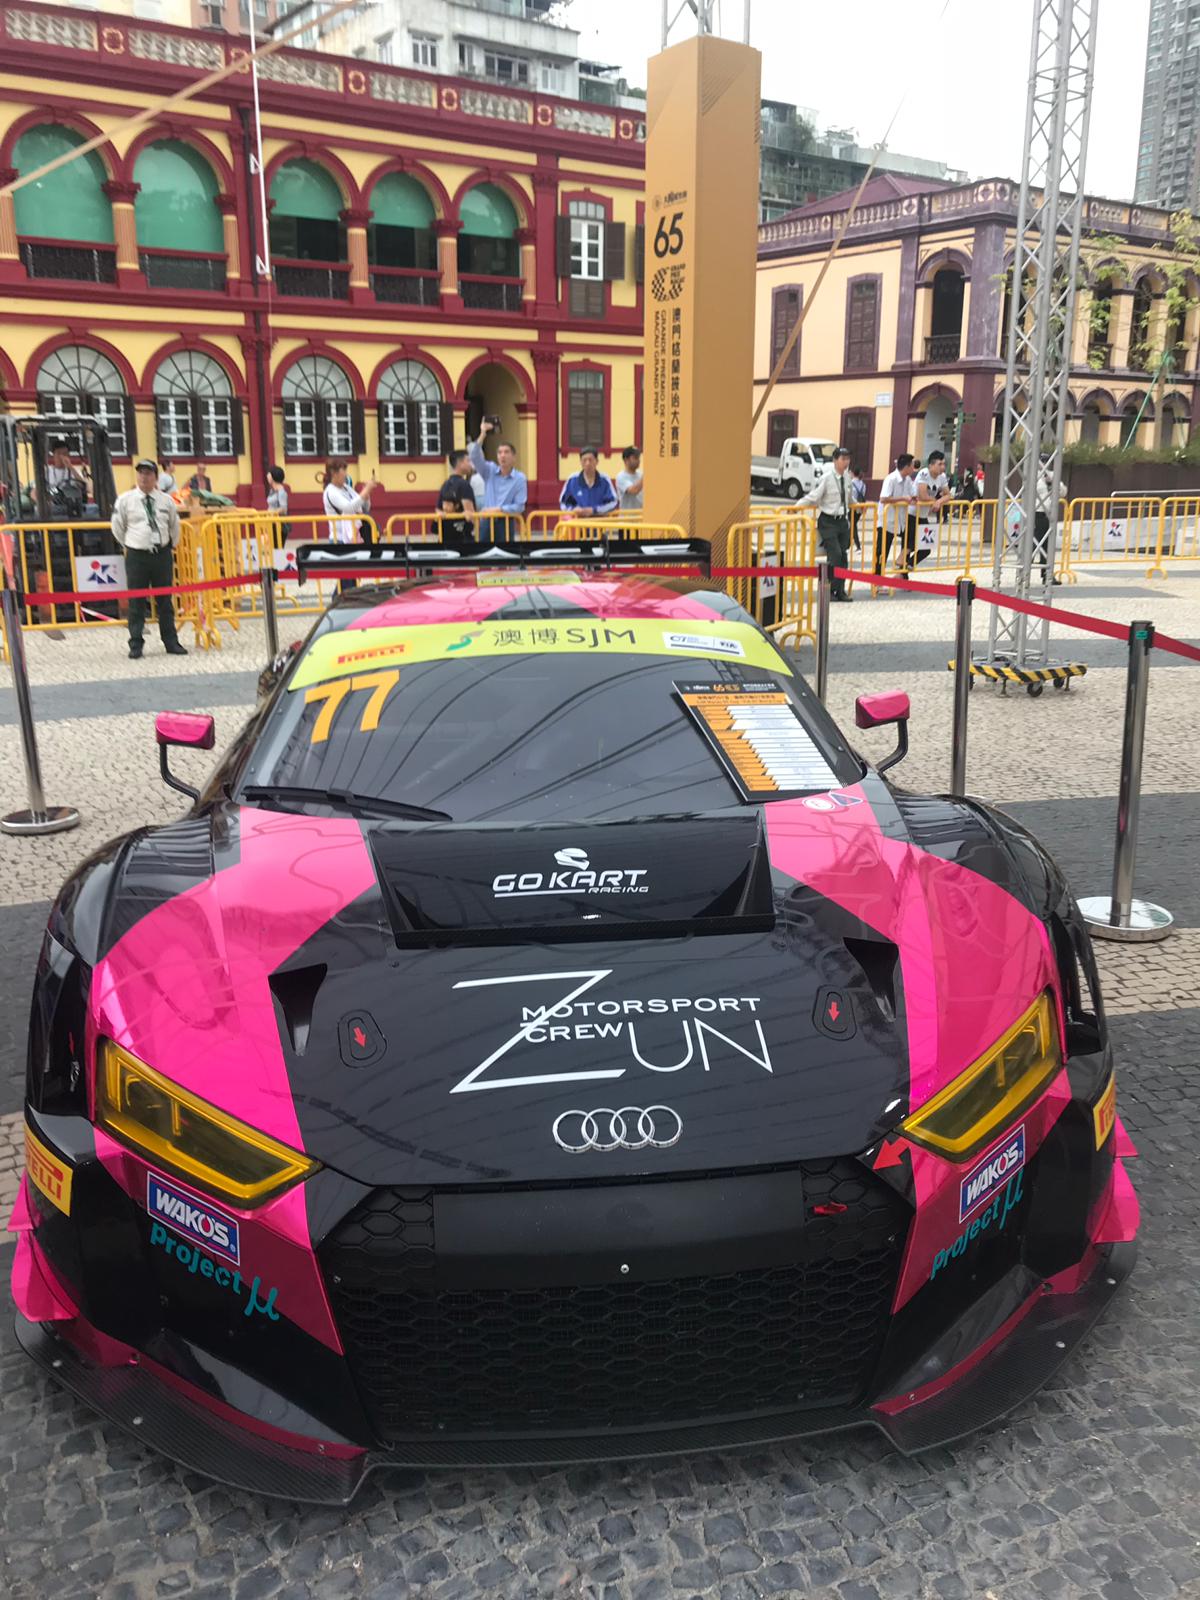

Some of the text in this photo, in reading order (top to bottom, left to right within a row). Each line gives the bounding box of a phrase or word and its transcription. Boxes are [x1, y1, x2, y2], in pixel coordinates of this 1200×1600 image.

[653, 212, 684, 259] 65
[659, 403, 666, 417] DE
[493, 628, 560, 647] 澳博
[566, 628, 637, 648] SJM
[304, 669, 400, 744] 77
[492, 869, 648, 893] GO KART
[587, 886, 649, 894] RACING
[521, 997, 761, 1021] MOTORSPORT
[524, 1022, 624, 1043] CREW
